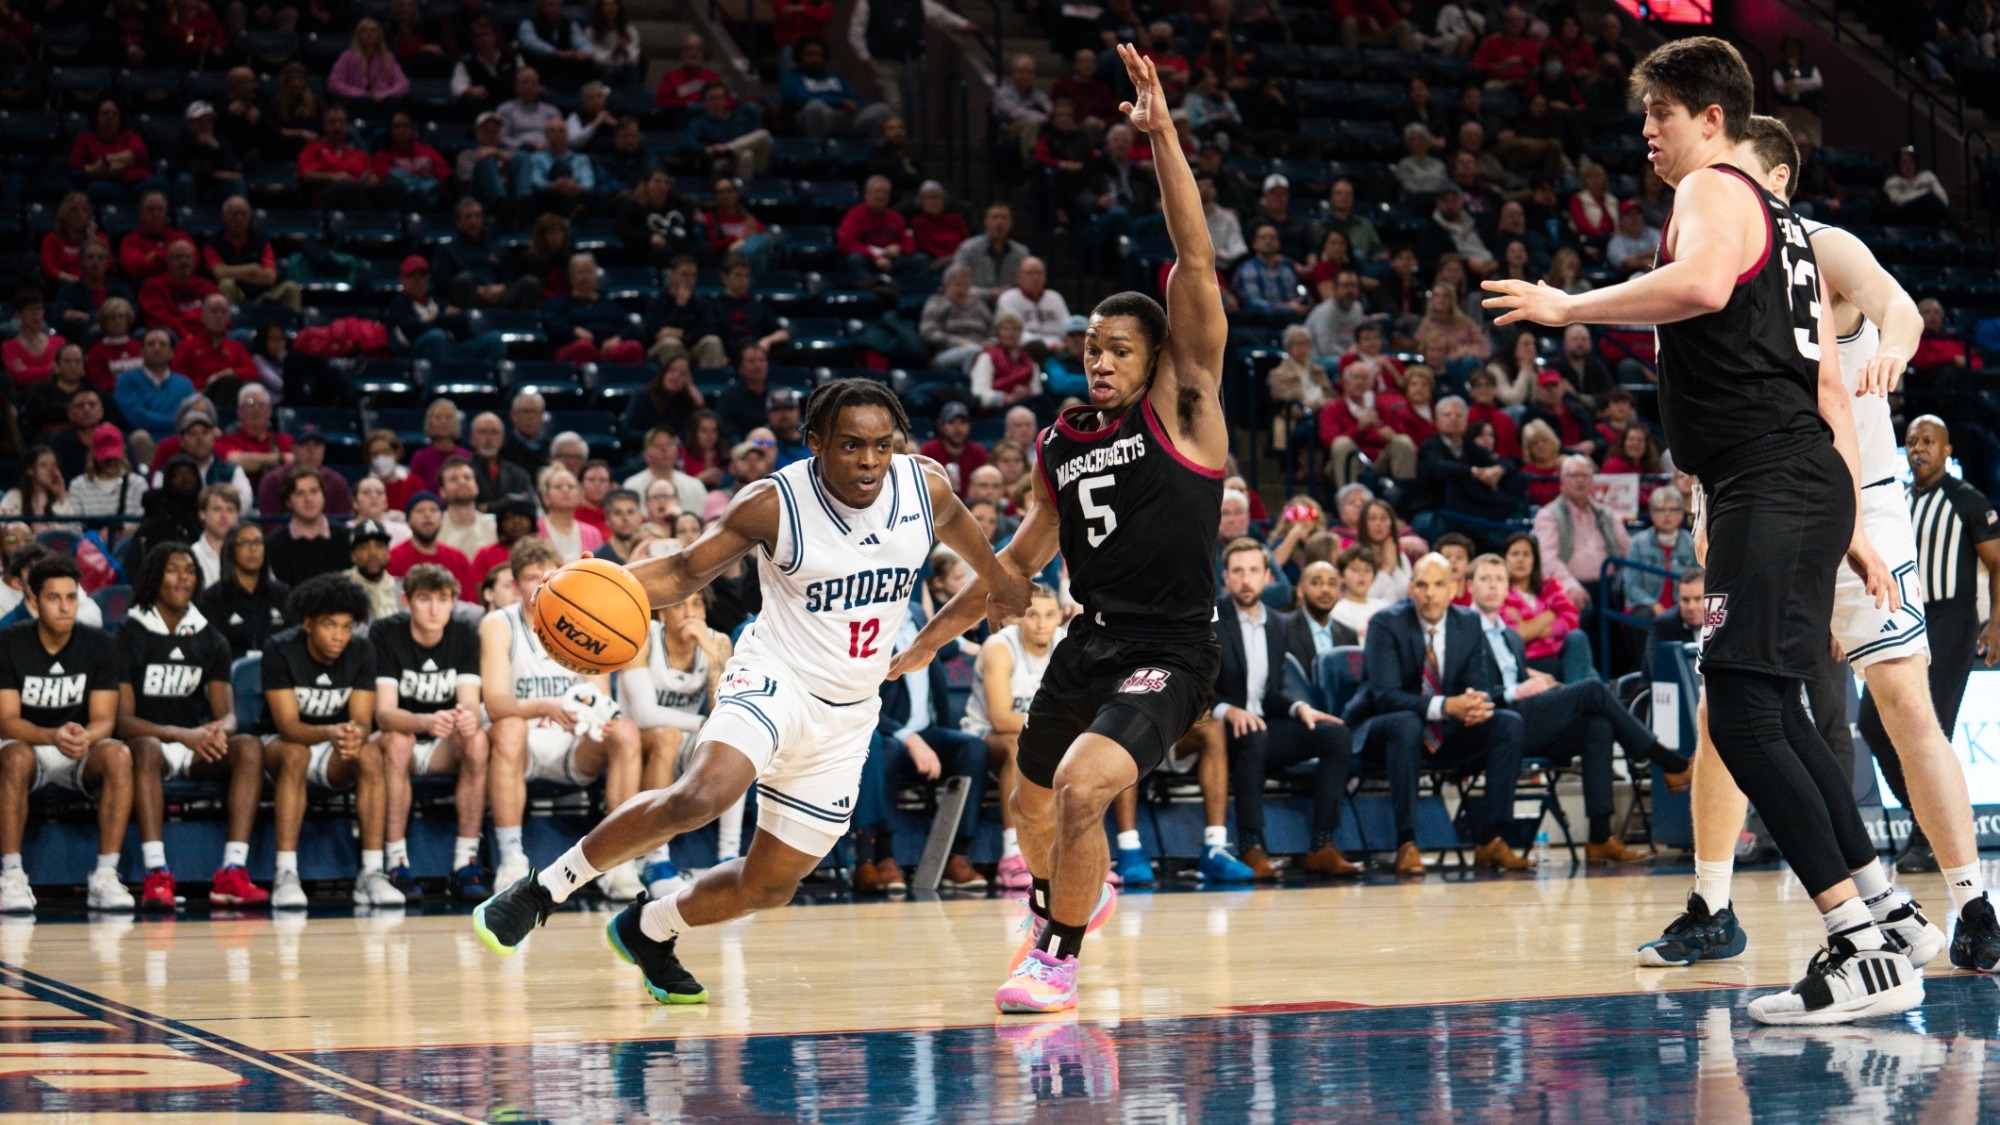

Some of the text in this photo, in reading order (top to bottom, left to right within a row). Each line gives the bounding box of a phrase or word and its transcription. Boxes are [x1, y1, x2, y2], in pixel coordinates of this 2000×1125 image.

[1056, 433, 1146, 491] MASSACHUSETTS
[1078, 474, 1118, 548] 5
[805, 567, 922, 613] SPIDERS
[555, 615, 607, 655] NCAA
[848, 618, 880, 659] 12
[22, 673, 87, 708] BHM
[143, 663, 203, 697] BHM
[1961, 721, 2000, 763] K
